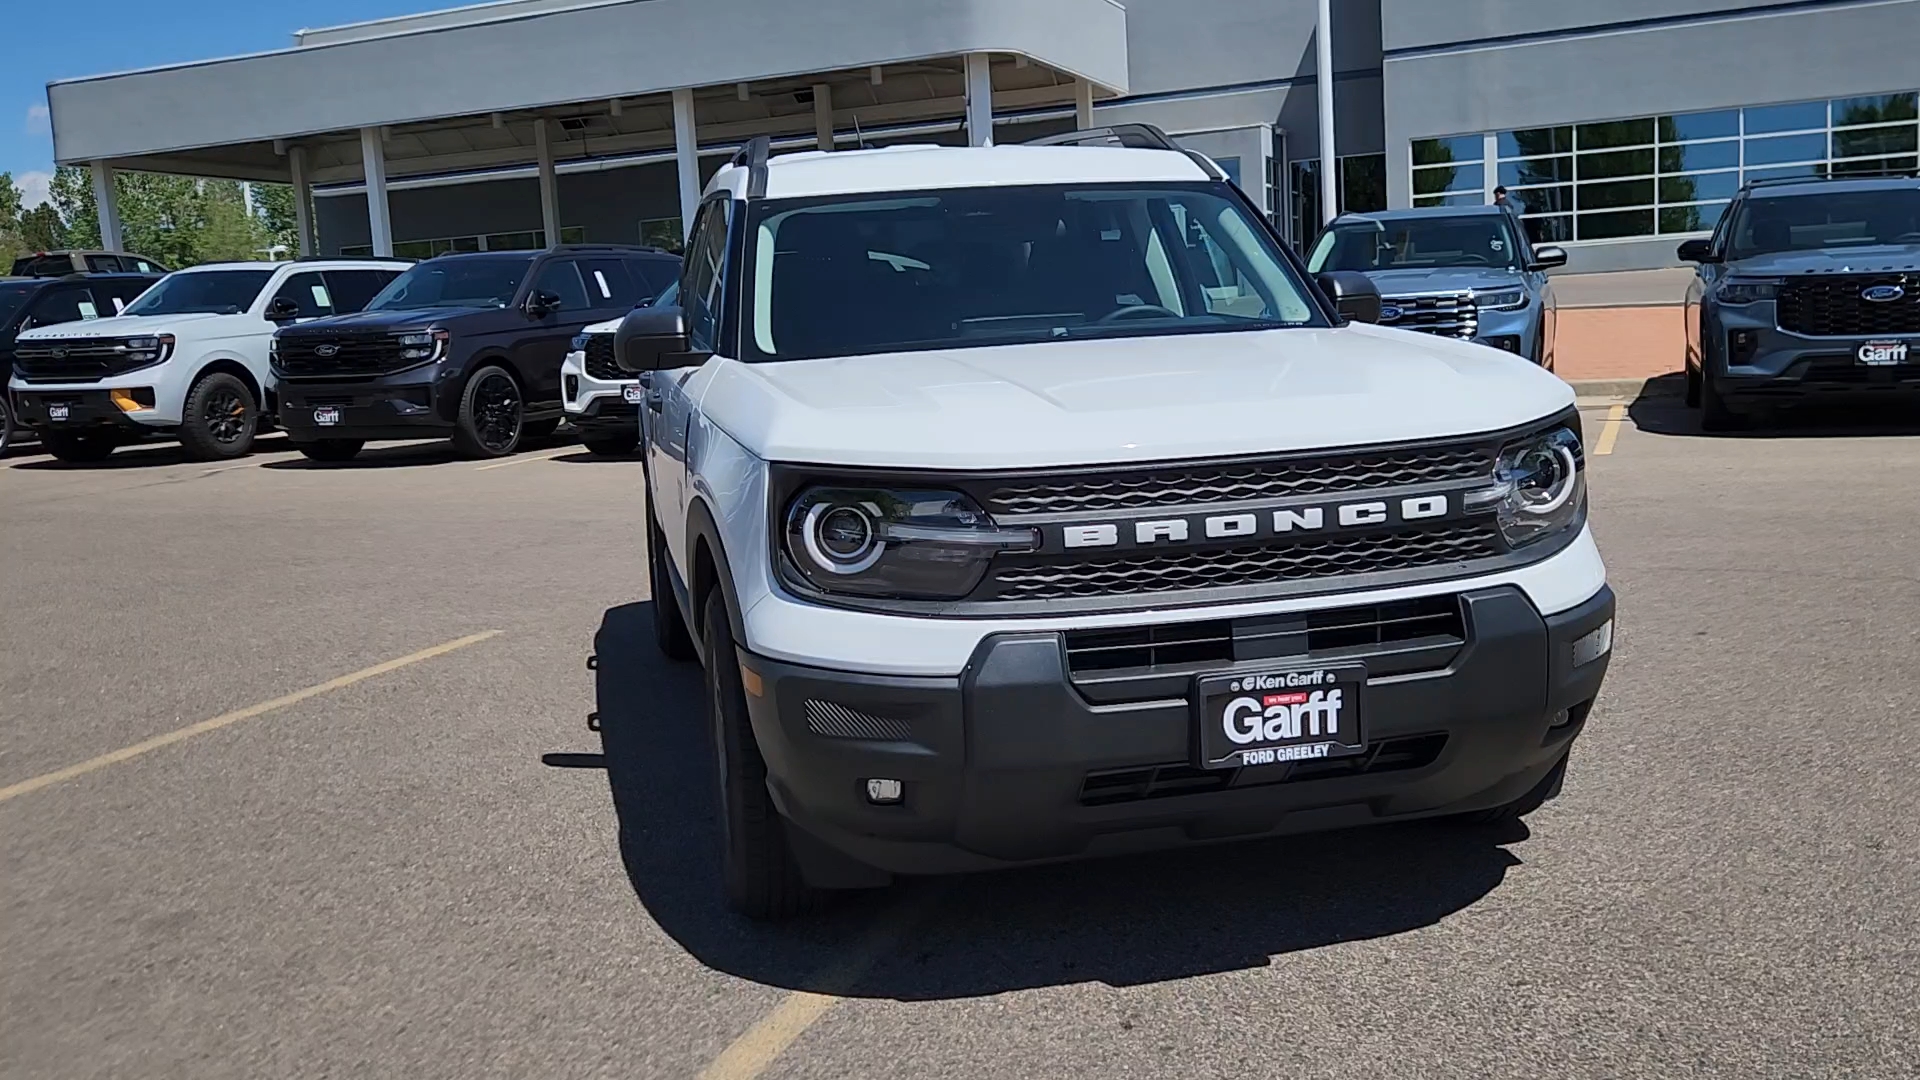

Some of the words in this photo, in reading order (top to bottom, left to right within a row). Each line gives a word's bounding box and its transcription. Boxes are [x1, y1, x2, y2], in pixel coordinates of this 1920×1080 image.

[1858, 343, 1908, 362] Garff
[623, 387, 641, 401] Ga
[313, 409, 339, 423] Garff
[1063, 495, 1448, 549] BRONCO
[1255, 674, 1285, 690] Ken
[1286, 670, 1324, 687] Garff
[1223, 689, 1342, 744] Garff
[1242, 750, 1275, 766] FORD
[1276, 744, 1330, 762] GREELEY
